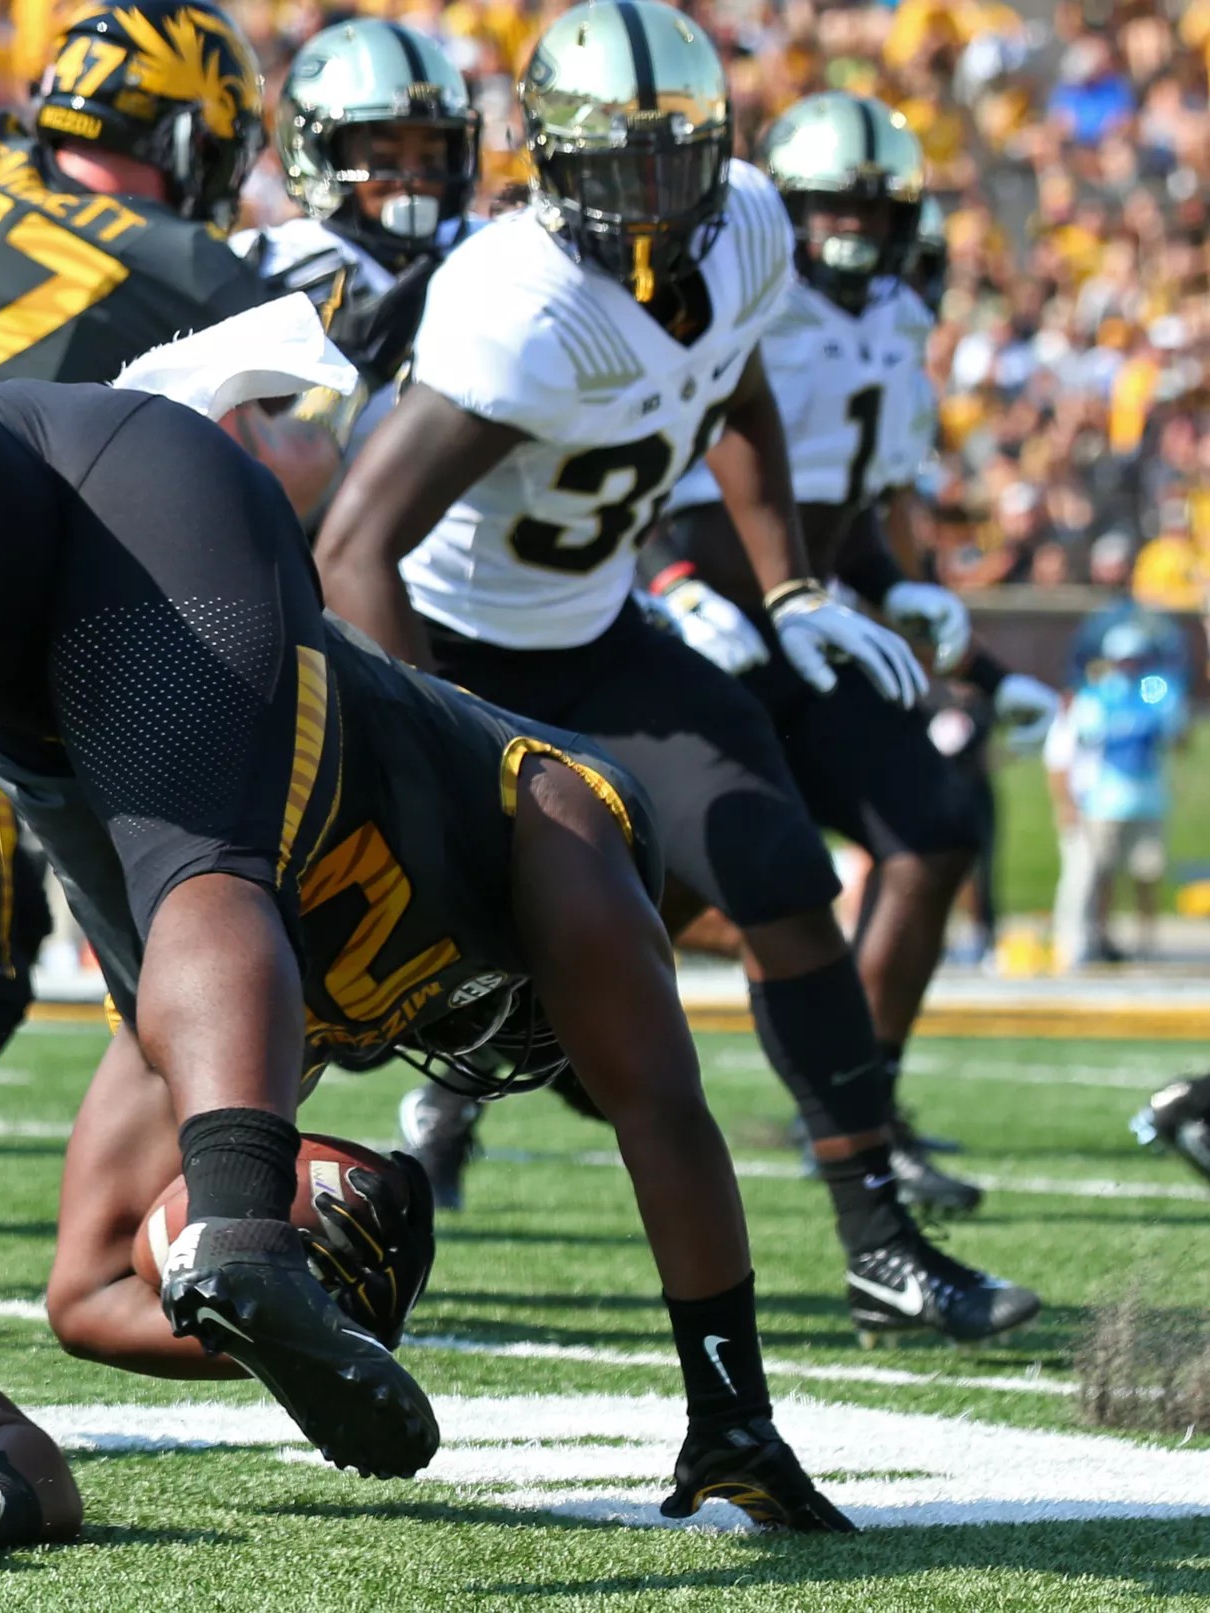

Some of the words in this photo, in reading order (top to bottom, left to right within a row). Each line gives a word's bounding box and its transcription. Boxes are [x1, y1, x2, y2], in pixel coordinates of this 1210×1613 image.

[56, 36, 127, 97] 47
[846, 382, 883, 505] 1
[452, 974, 503, 1006] SEC
